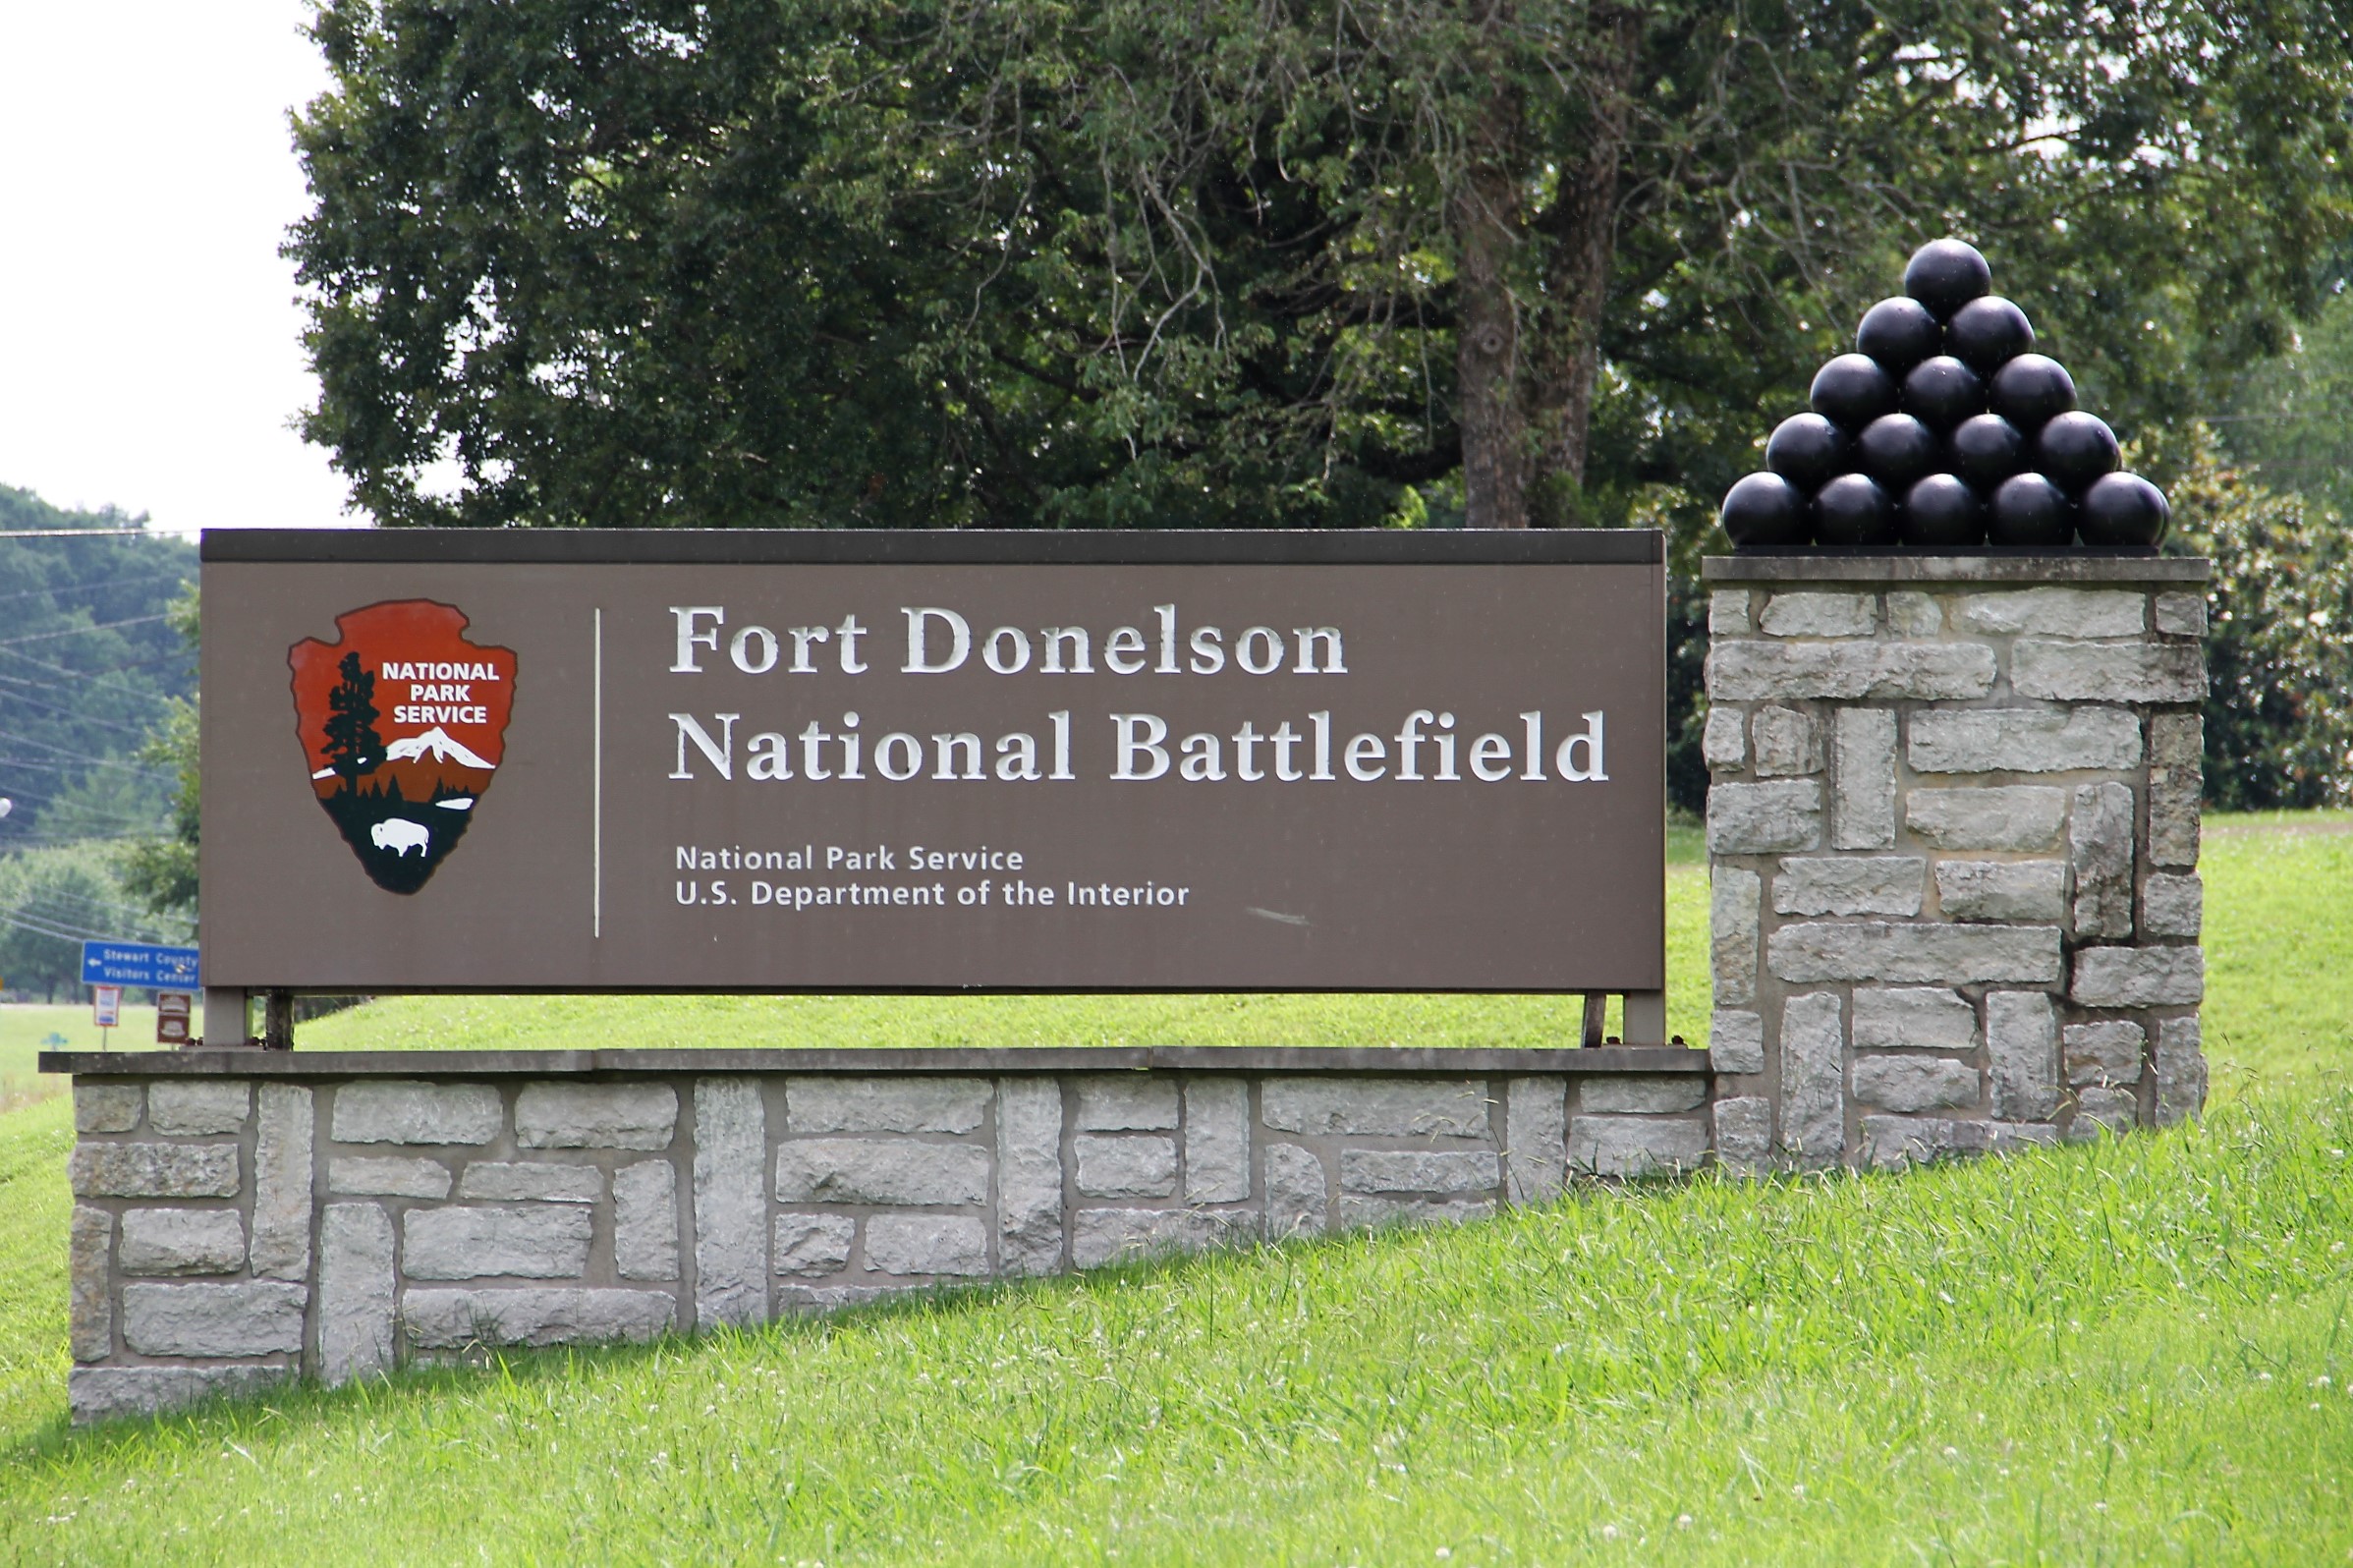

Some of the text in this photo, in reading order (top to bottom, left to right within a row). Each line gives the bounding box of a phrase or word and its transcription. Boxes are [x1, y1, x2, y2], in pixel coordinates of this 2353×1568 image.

[669, 603, 1349, 675] Fort Donelson
[381, 662, 500, 681] NATIONAL
[410, 684, 471, 702] PARK
[393, 704, 487, 724] SERVICE
[668, 709, 1609, 782] National Battlefield
[675, 844, 1024, 870] National Park Service
[675, 879, 1190, 912] U.S. Department of the Interior
[103, 948, 197, 969] Stewart County
[103, 967, 196, 983] Visitors Center
